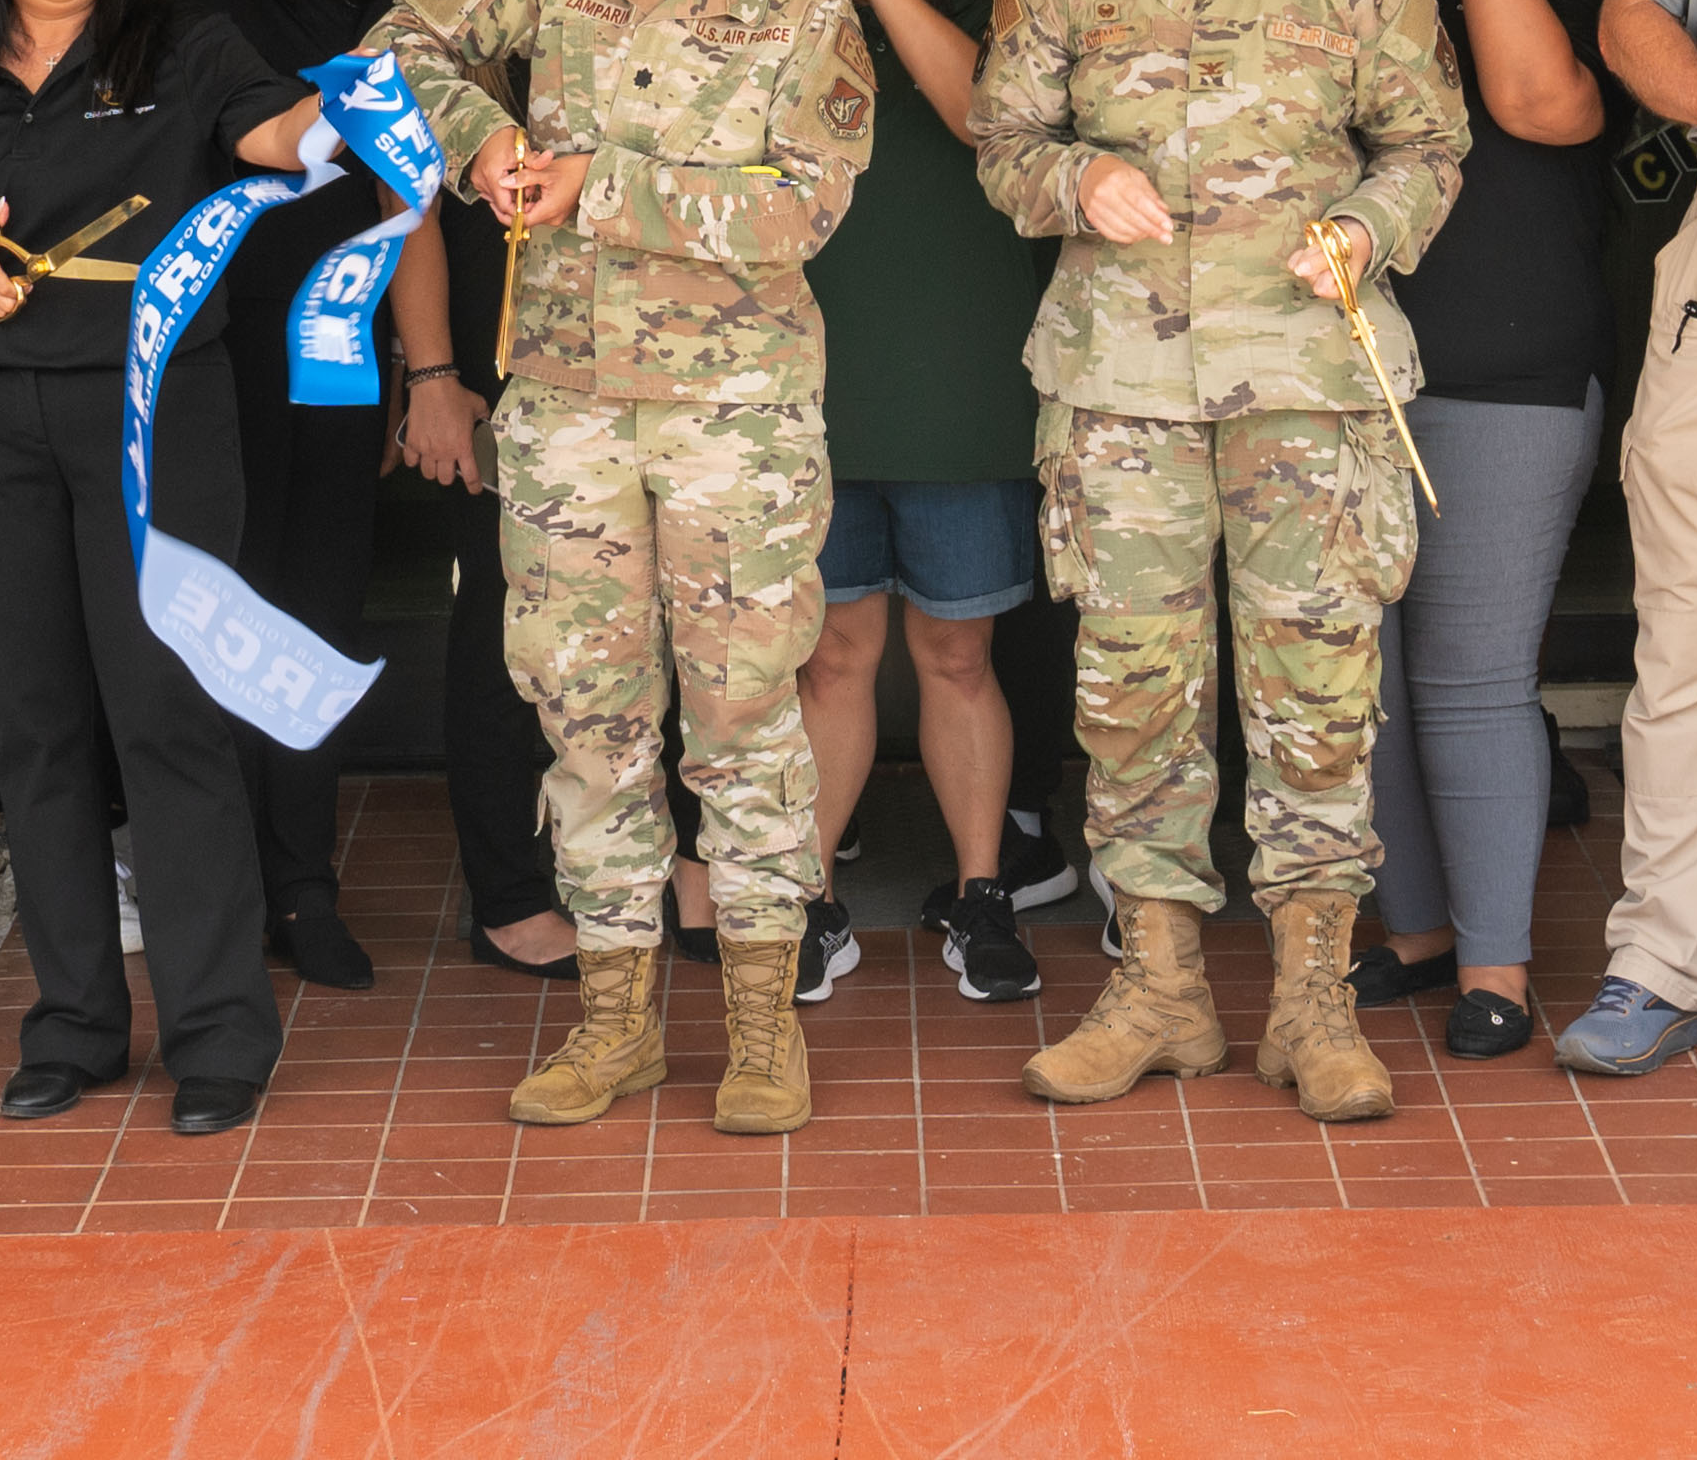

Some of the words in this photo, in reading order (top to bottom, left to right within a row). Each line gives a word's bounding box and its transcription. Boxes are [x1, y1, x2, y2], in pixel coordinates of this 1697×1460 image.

[696, 23, 719, 43] U.S.
[723, 29, 745, 45] AIR
[749, 27, 791, 45] FORCE
[1272, 23, 1296, 38] U.S.
[1301, 27, 1321, 41] AIR
[1324, 32, 1355, 55] FORCE
[842, 36, 873, 77] FSS
[148, 253, 175, 288] AIR
[175, 196, 224, 250] FORCE
[128, 181, 301, 418] FORCE
